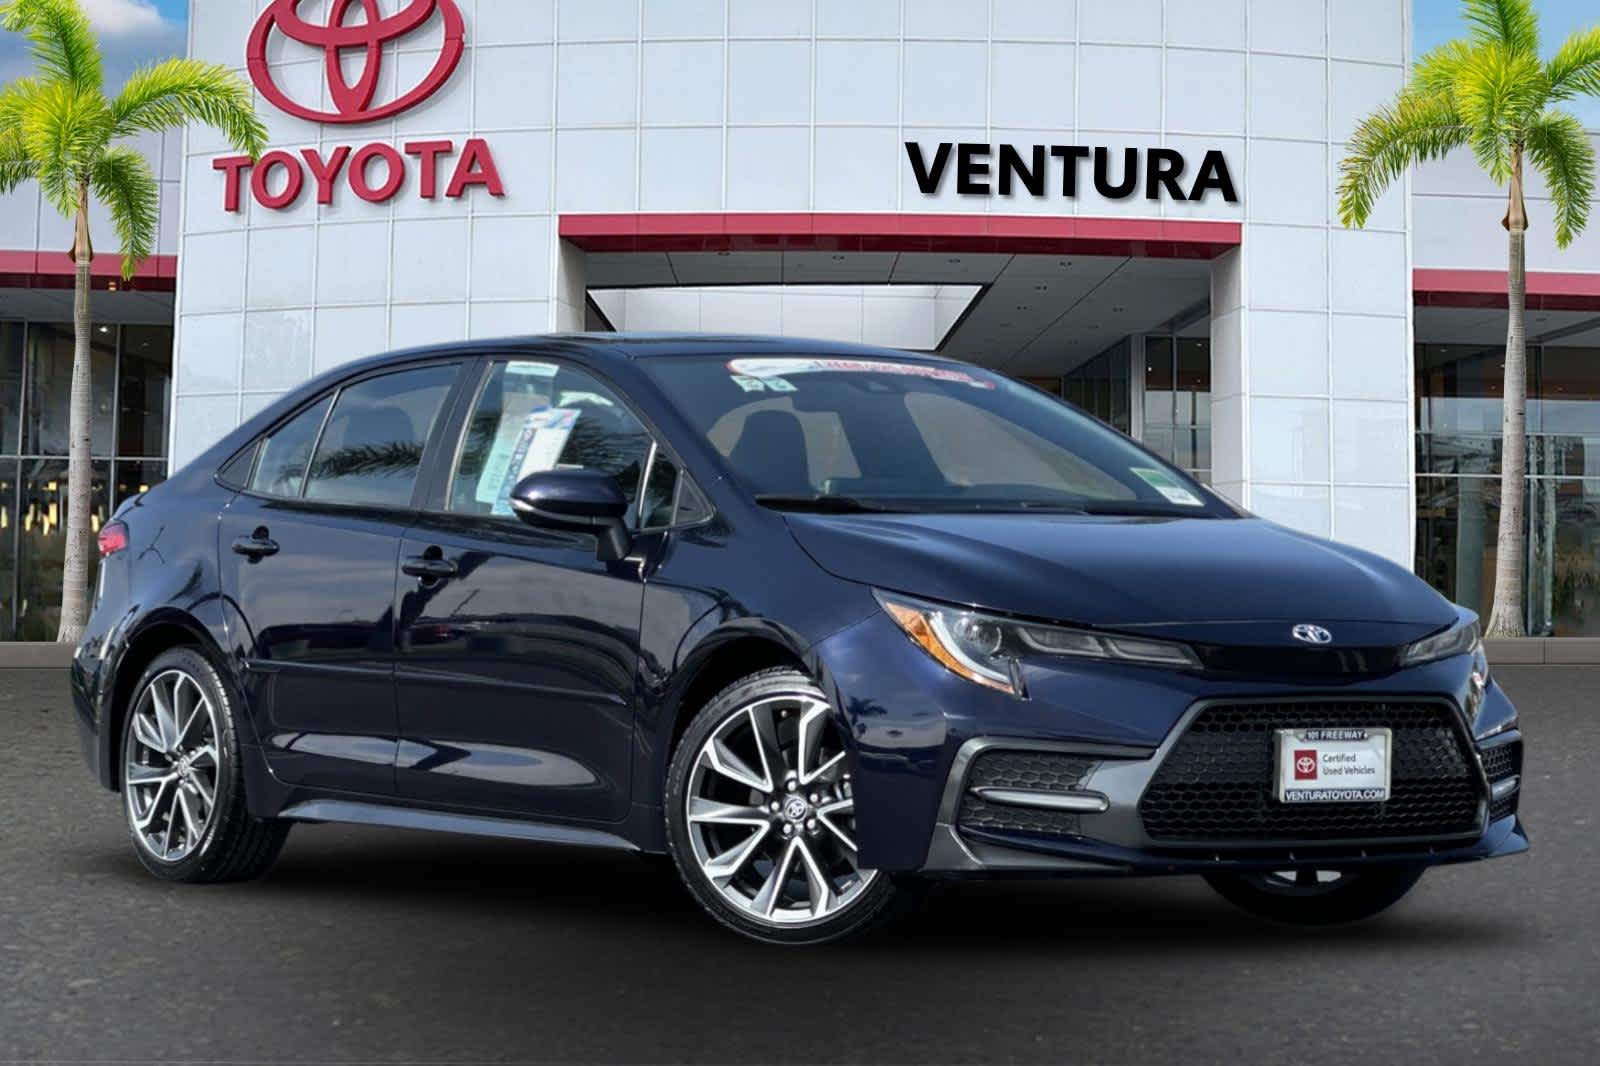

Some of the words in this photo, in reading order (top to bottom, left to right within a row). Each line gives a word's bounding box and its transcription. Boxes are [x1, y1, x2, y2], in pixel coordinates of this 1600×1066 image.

[212, 138, 505, 212] TOYOTA
[905, 142, 1238, 203] VENTURA
[1307, 730, 1319, 739] 101
[1321, 730, 1362, 739] FREEWAY
[1322, 754, 1356, 763] Certified
[1323, 767, 1342, 776] Used
[1344, 765, 1375, 776] Vehicles
[1285, 789, 1385, 800] VENTURATOYOTA.COM
